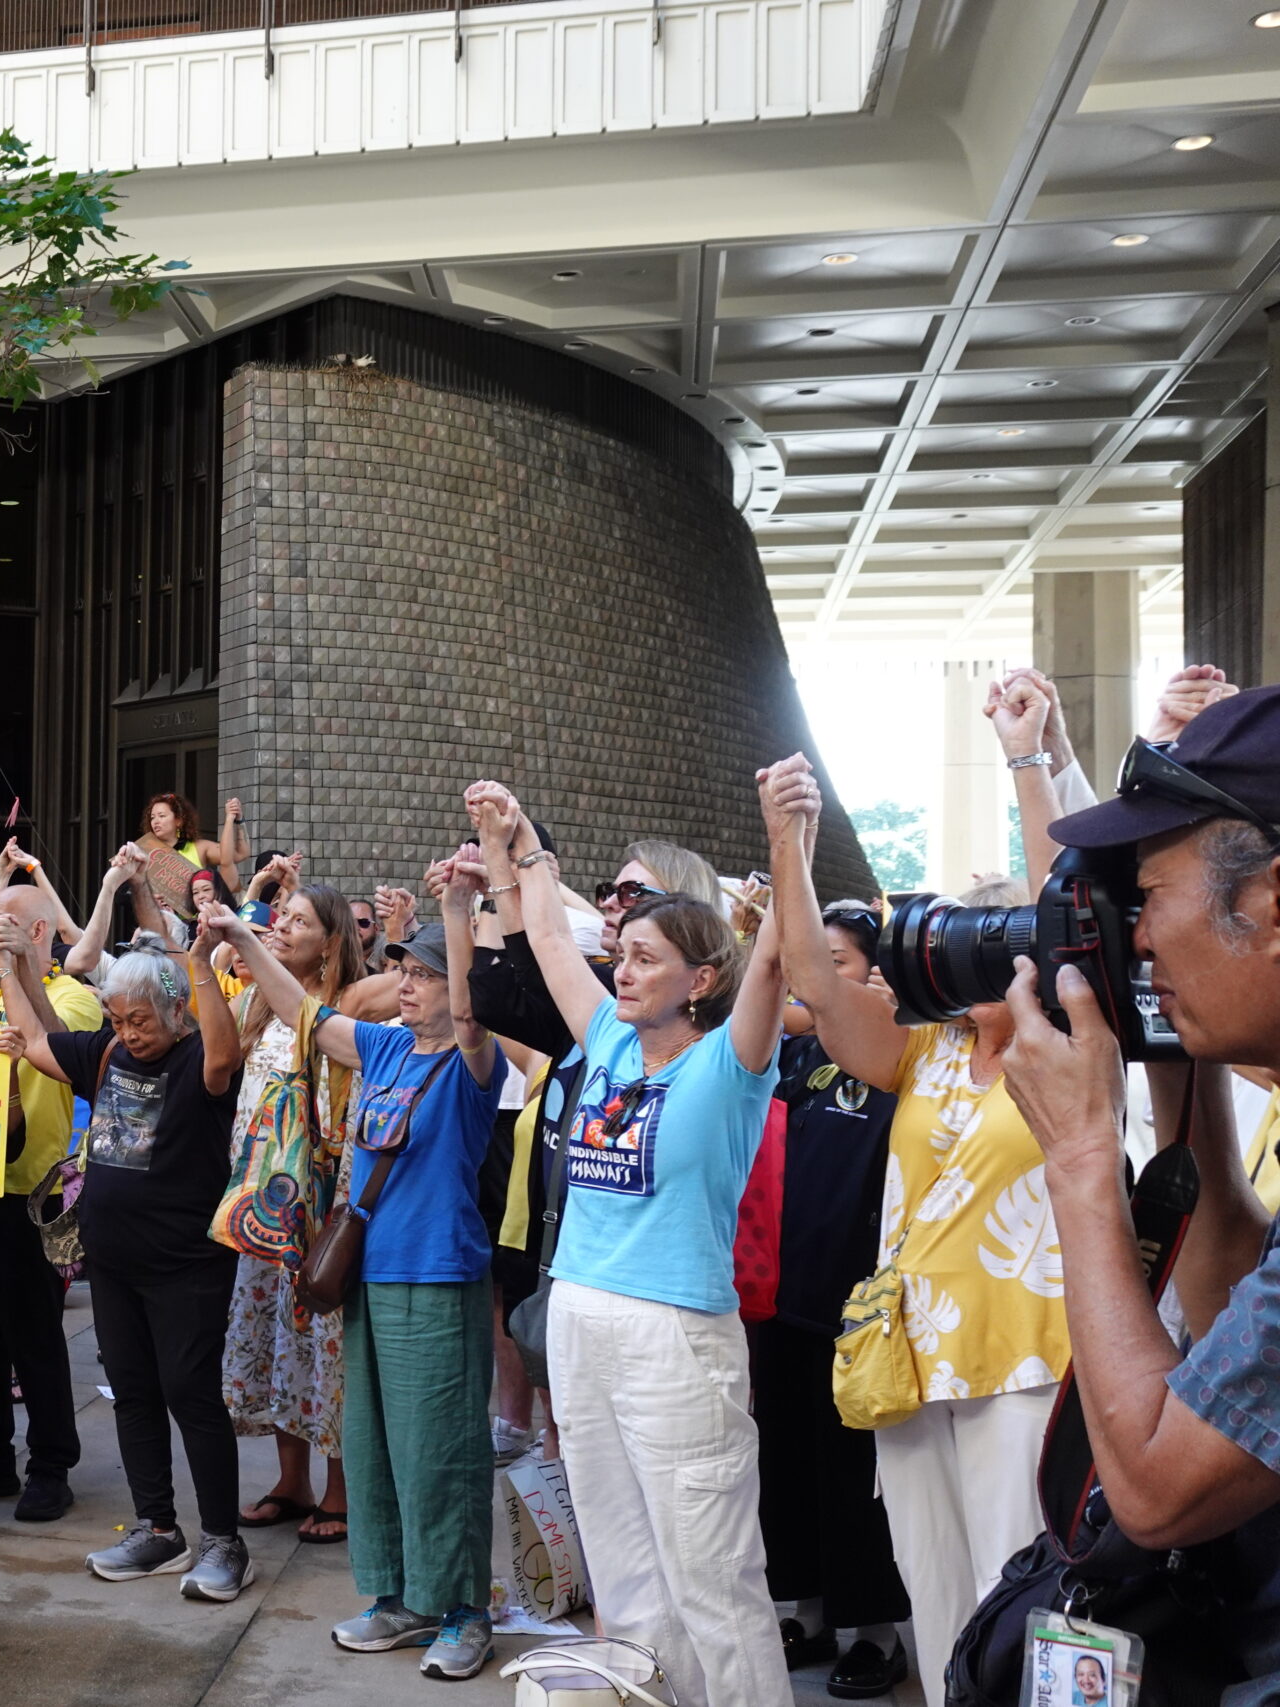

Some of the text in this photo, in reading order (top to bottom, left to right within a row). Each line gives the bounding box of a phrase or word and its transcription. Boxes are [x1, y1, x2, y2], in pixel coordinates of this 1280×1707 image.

[569, 1146, 639, 1166] INDIVISIBLE
[506, 1496, 521, 1525] MAY
[523, 1490, 573, 1604] DOMESTIC
